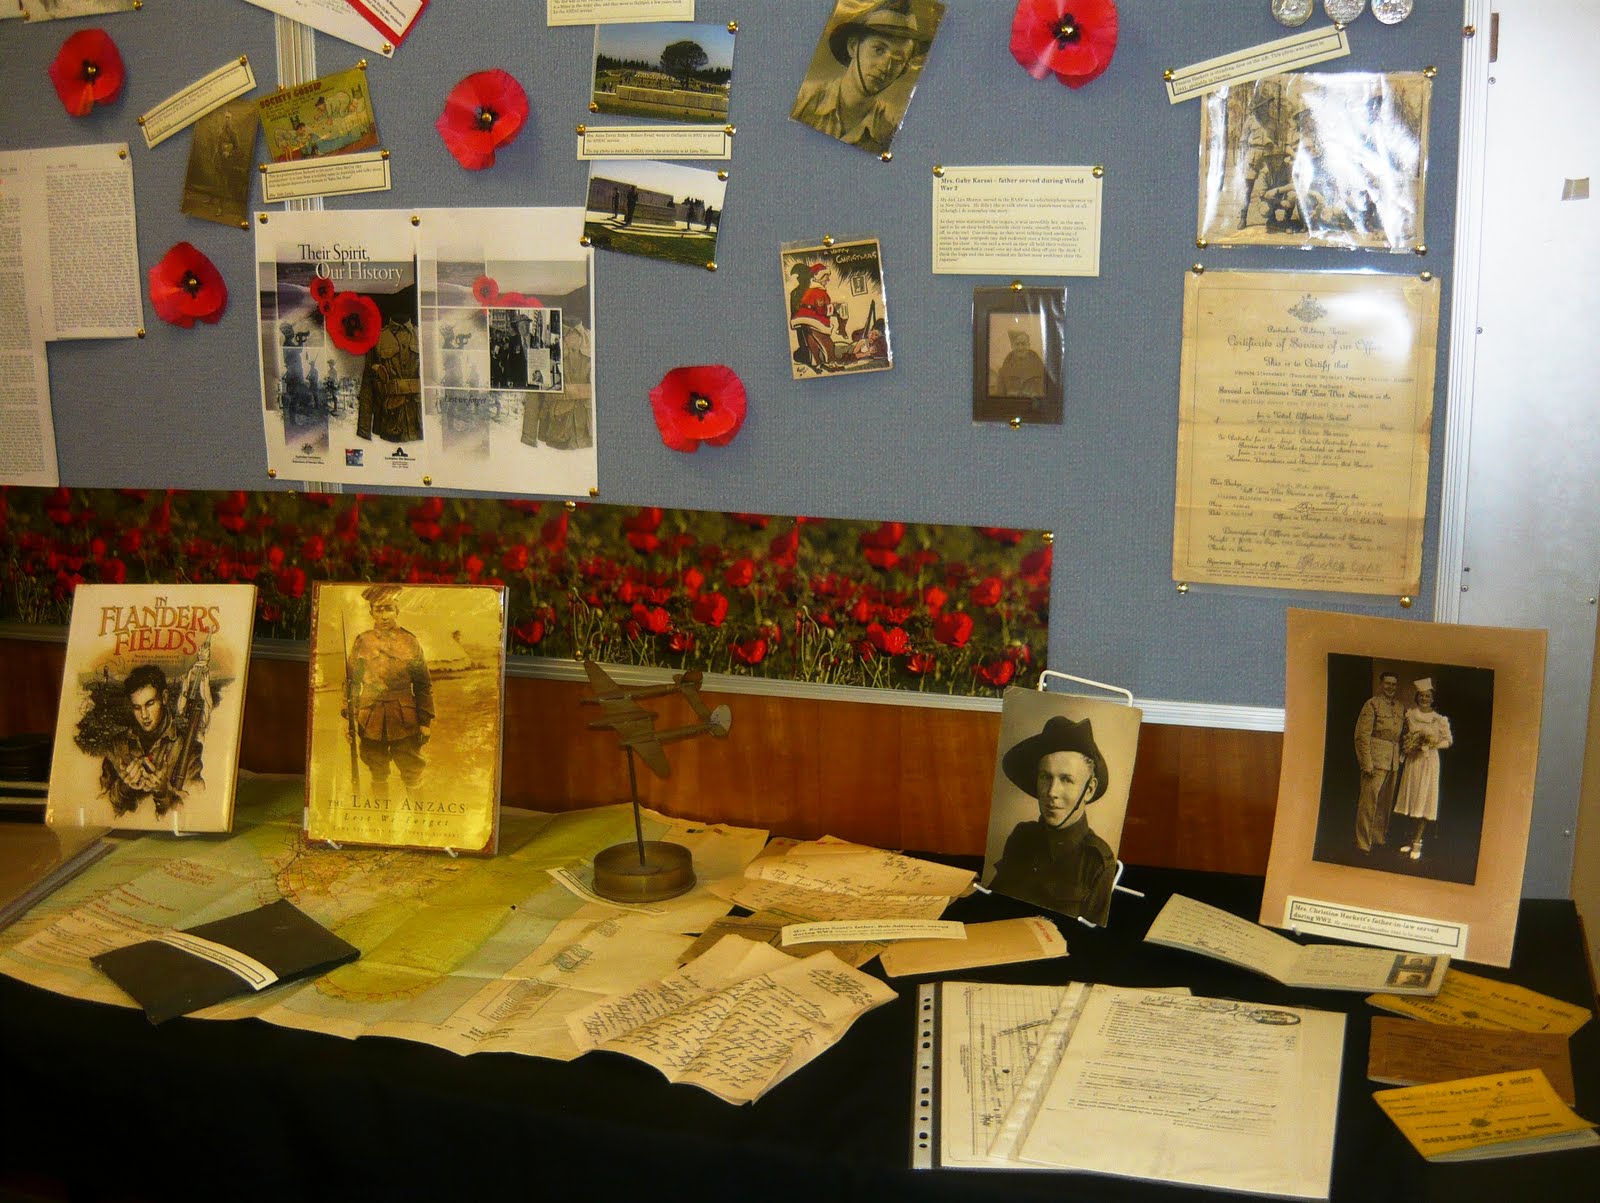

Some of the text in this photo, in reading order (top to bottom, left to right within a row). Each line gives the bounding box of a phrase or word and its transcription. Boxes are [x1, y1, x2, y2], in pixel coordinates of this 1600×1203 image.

[956, 177, 970, 186] Gaby
[1041, 177, 1064, 185] during
[298, 243, 370, 266] Their Spirit,
[315, 262, 404, 287] Our History
[1228, 335, 1273, 352] Certificate
[1276, 339, 1286, 352] of
[1289, 335, 1325, 351] Service
[1327, 339, 1338, 354] of
[1264, 356, 1282, 367] This
[1304, 358, 1330, 372] Certify
[1334, 361, 1349, 370] that
[155, 596, 168, 606] IN
[98, 605, 220, 637] FLANDERS
[113, 628, 198, 656] FIELDS
[352, 795, 392, 810] LAST
[401, 798, 466, 814] ANZACS
[344, 812, 371, 822] Lest
[406, 816, 450, 827] Forget
[1293, 912, 1314, 922] during
[1295, 904, 1308, 912] Mrs.
[1309, 906, 1338, 917] Christine
[1340, 912, 1370, 924] Hackett's
[1416, 925, 1440, 934] served
